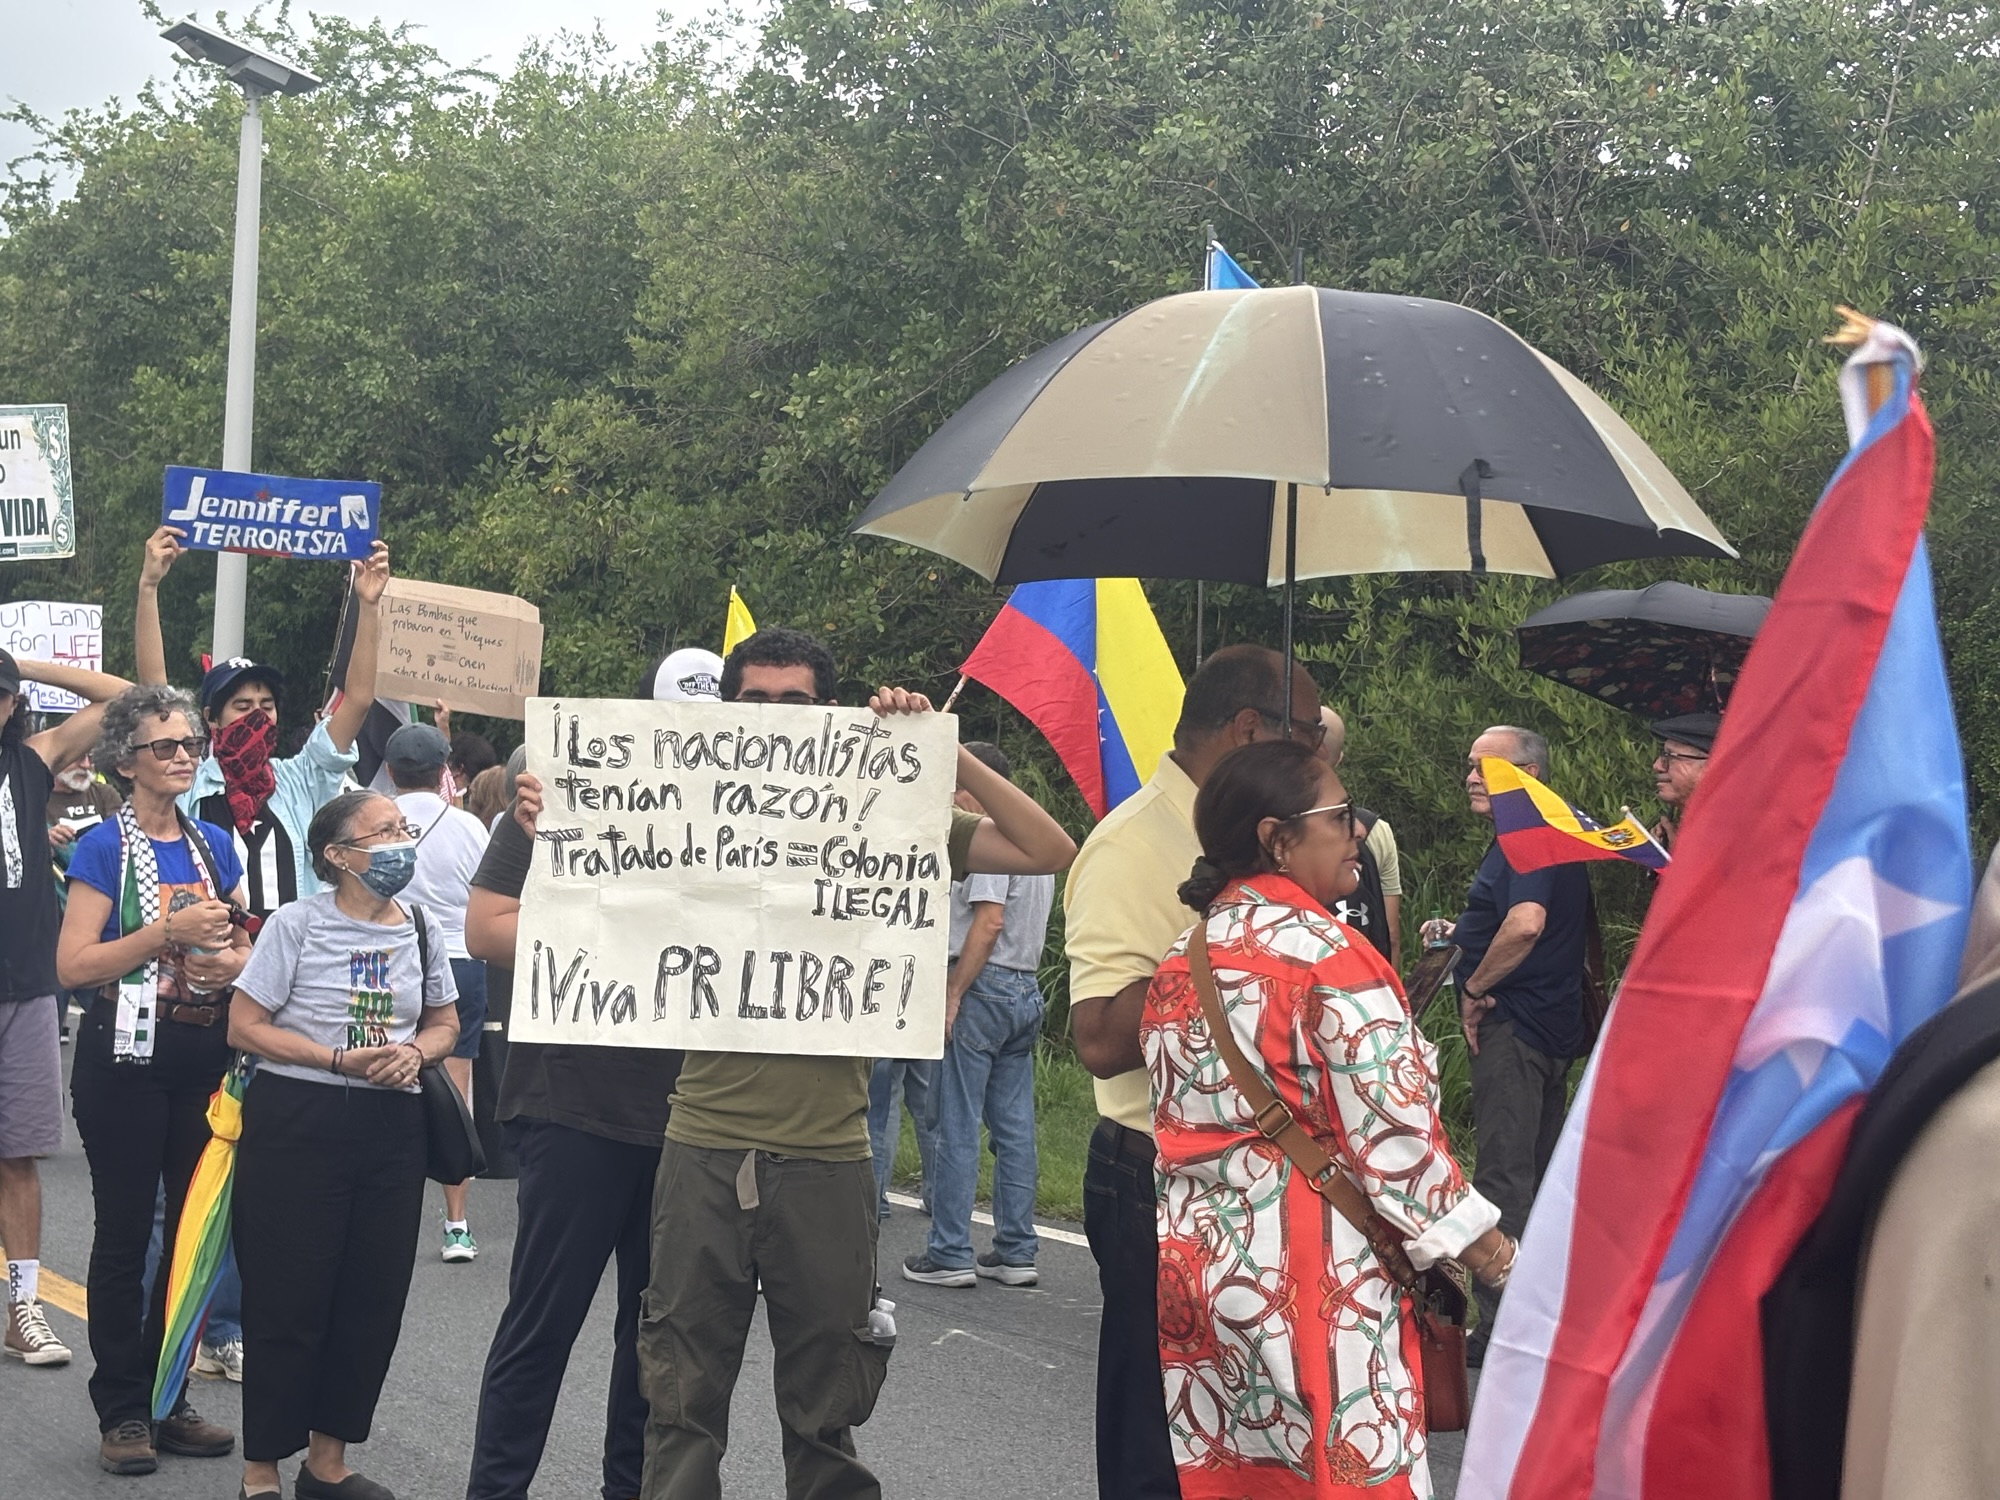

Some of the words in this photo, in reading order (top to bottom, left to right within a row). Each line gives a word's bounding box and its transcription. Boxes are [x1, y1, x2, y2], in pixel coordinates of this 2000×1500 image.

[0, 498, 49, 537] VIDA
[168, 476, 337, 527] Jenniffer
[192, 521, 347, 555] TERRORISTA
[417, 603, 453, 622] Bombas
[457, 615, 478, 634] que
[439, 628, 451, 637] en
[6, 630, 48, 653] for
[52, 633, 101, 658] LIFE
[390, 639, 412, 663] hoy
[654, 712, 922, 783] nacionalistas
[555, 770, 682, 812] tenían
[536, 823, 673, 878] Tratado
[680, 822, 707, 867] de
[716, 825, 778, 872] París
[820, 836, 940, 881] Colonia
[812, 878, 935, 930] ILEGAL
[652, 944, 722, 1022] PR
